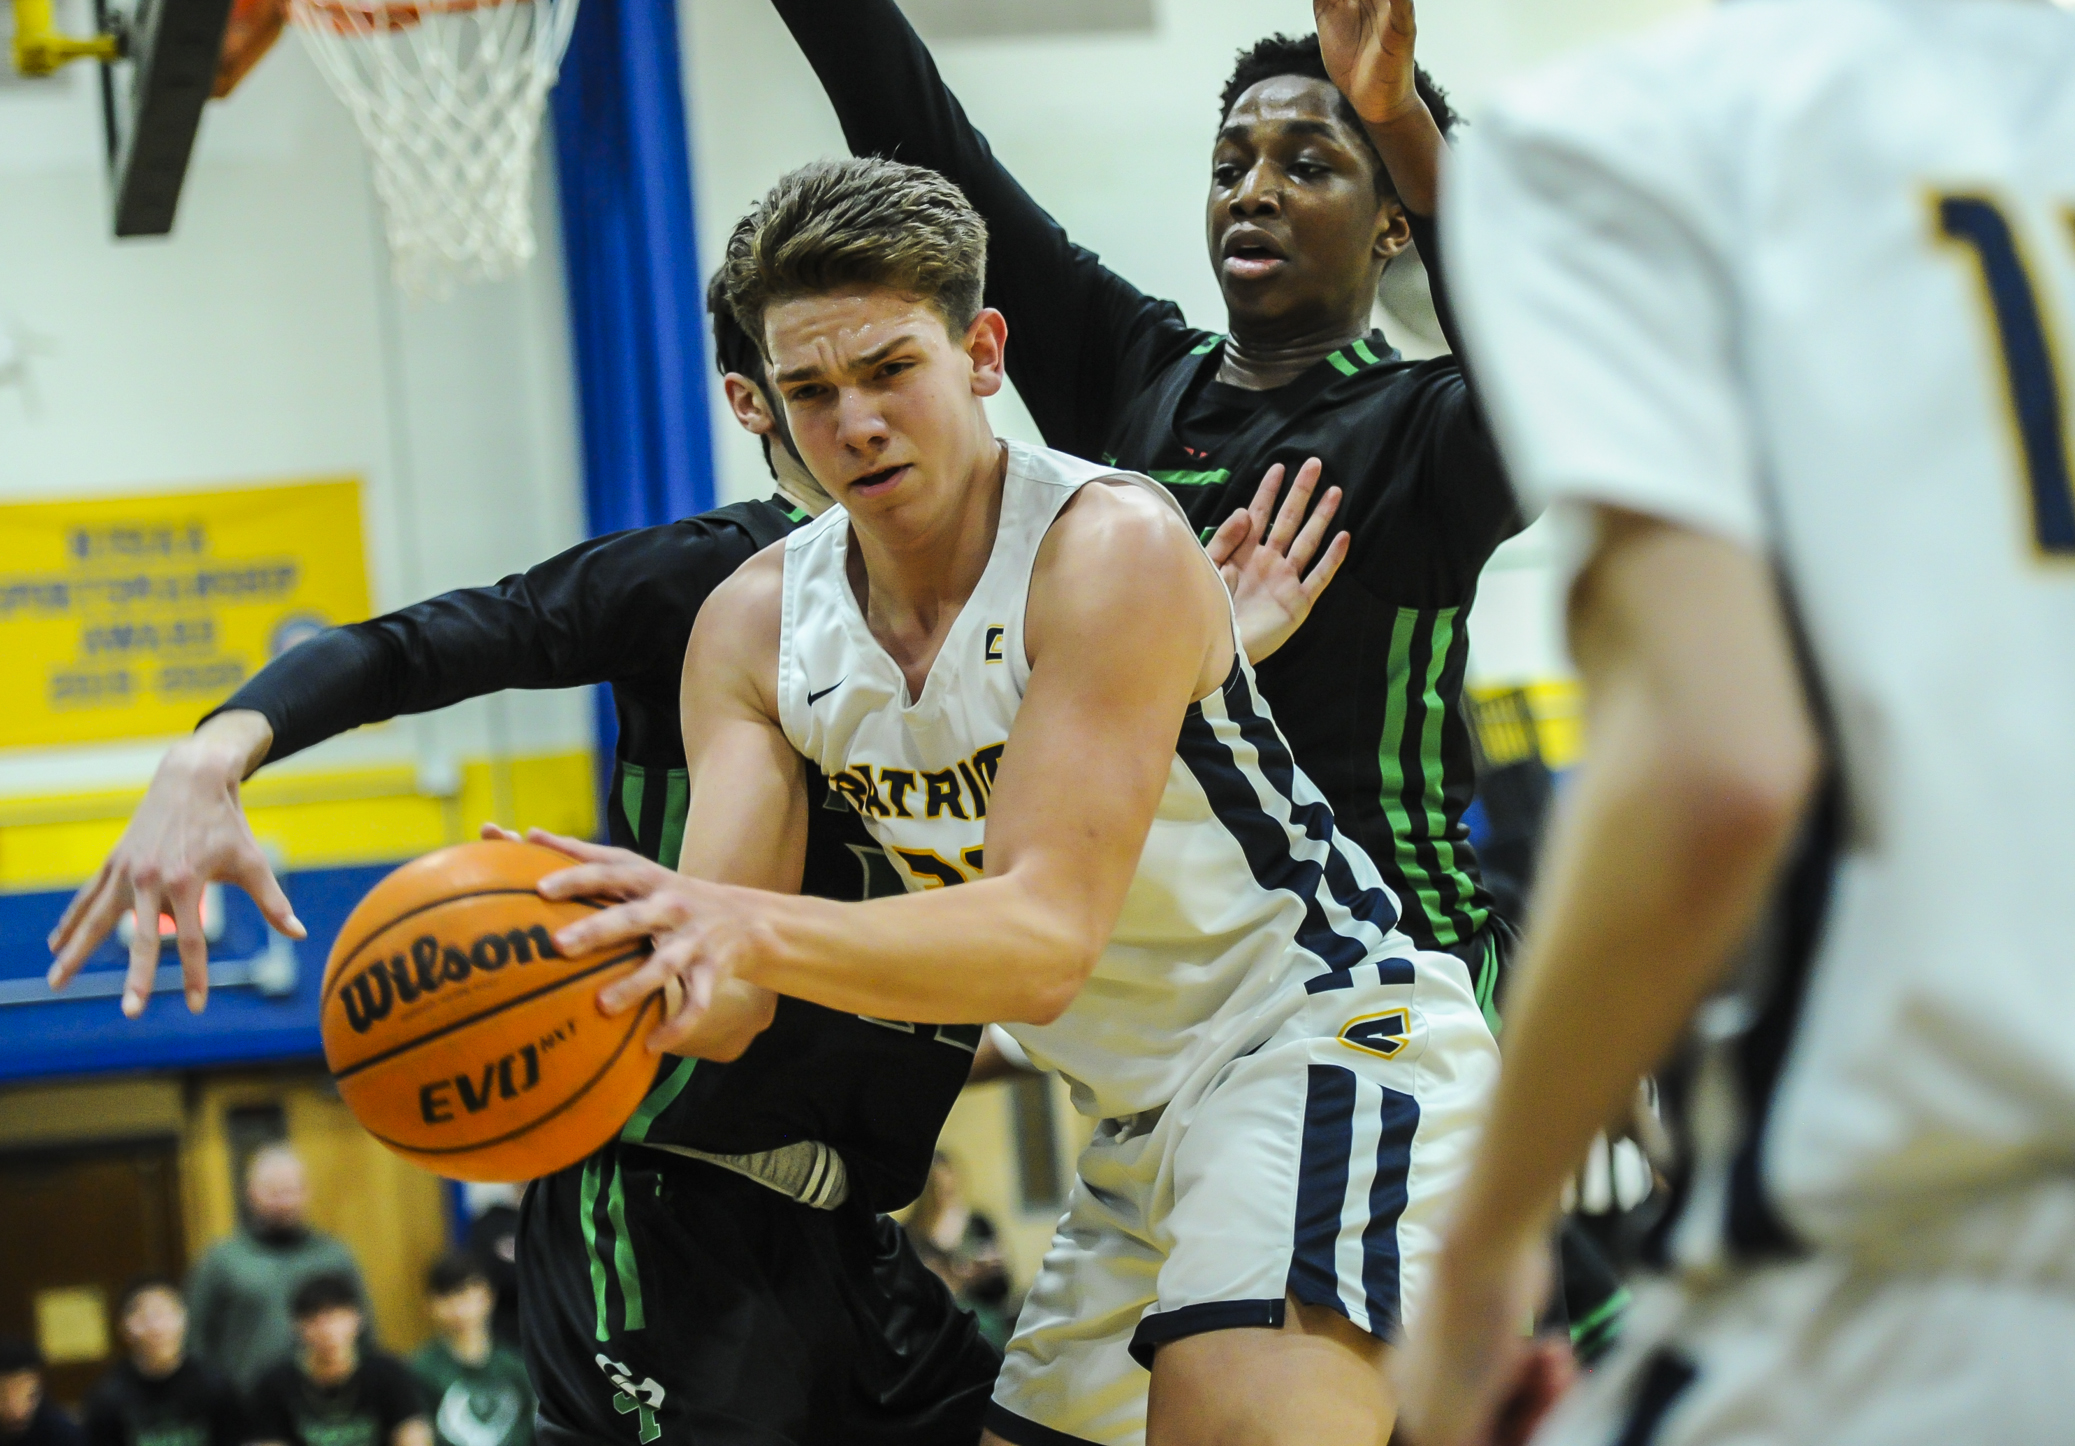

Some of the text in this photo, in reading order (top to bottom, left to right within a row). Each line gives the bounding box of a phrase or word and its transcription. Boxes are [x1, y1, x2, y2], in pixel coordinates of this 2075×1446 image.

[1928, 186, 2075, 558] 1
[340, 924, 559, 1034] Wilson
[418, 1042, 541, 1124] EVO
